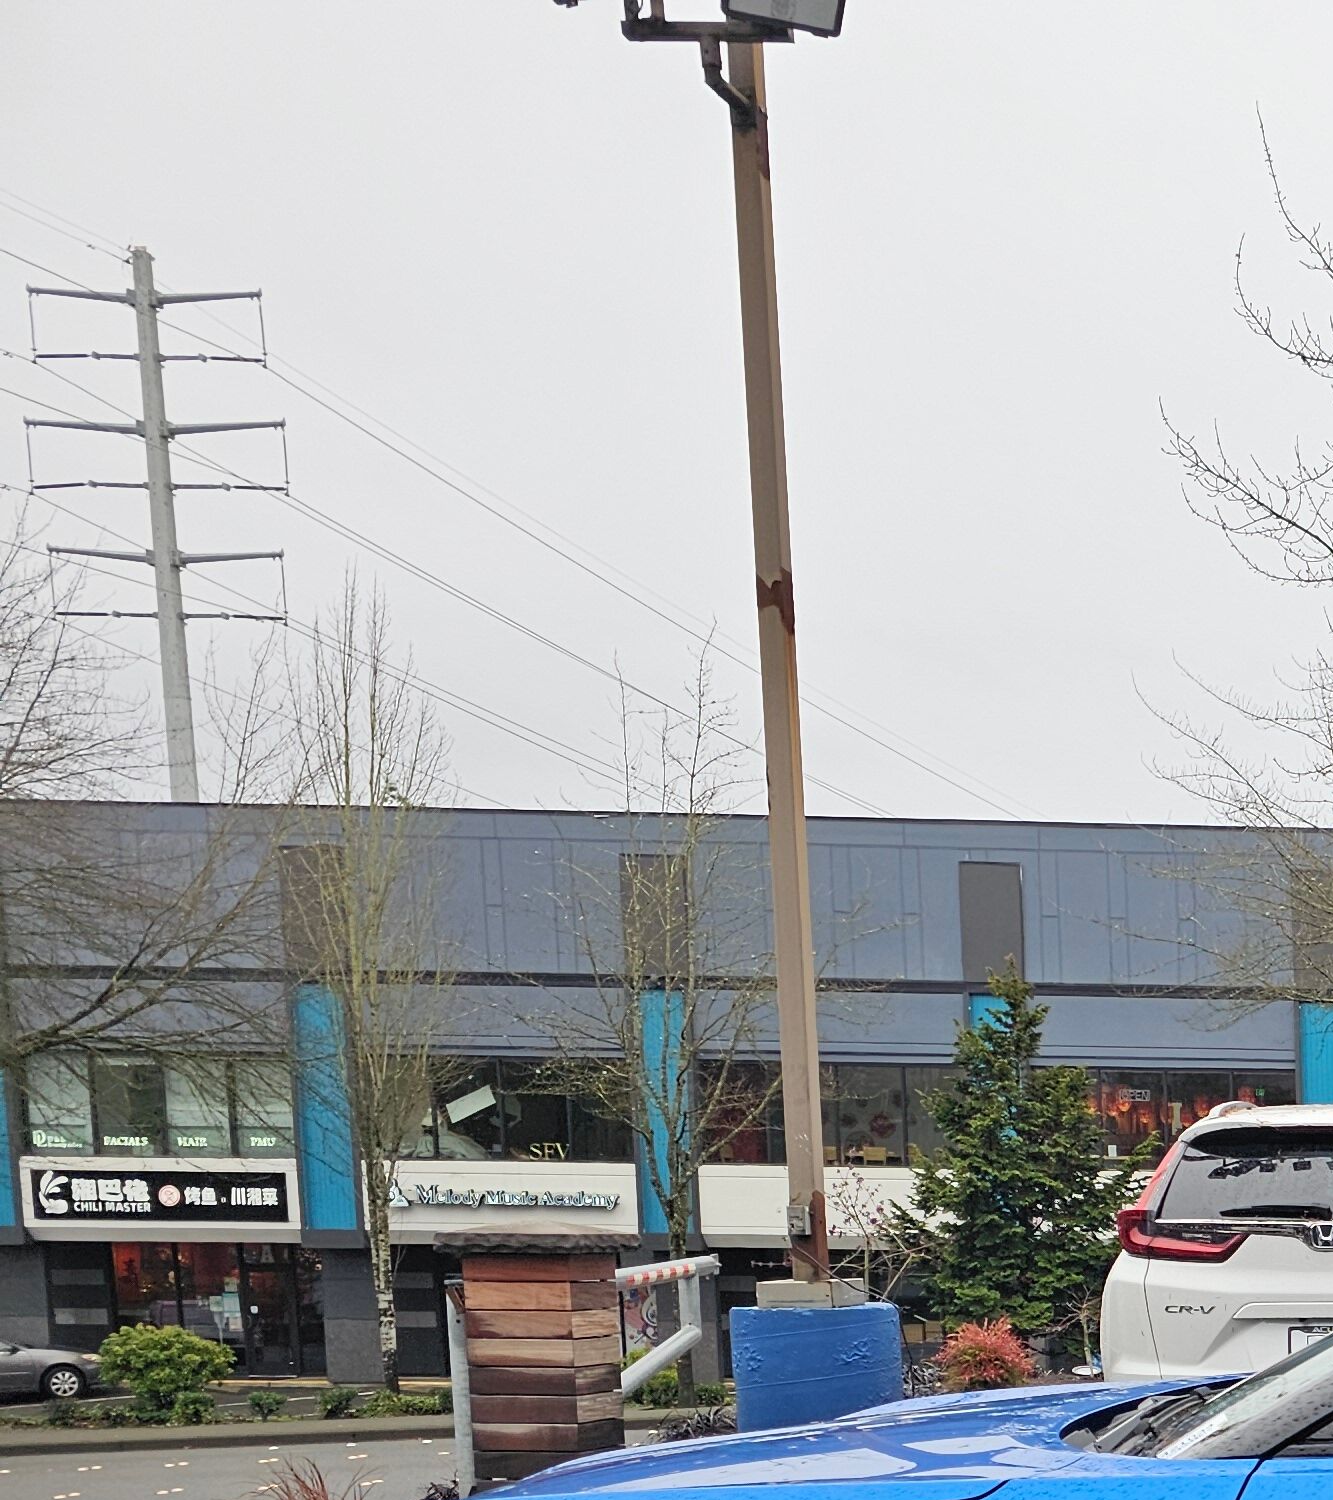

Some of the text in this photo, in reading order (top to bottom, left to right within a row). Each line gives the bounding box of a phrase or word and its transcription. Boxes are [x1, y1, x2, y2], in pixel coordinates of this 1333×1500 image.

[1121, 1089, 1149, 1101] OPEN
[103, 1136, 149, 1147] FACIALS
[176, 1136, 208, 1147] HAIR
[415, 1184, 620, 1210] Melody Music Academy
[73, 1202, 151, 1213] CHILI MASTER
[1165, 1305, 1216, 1315] CR-V
